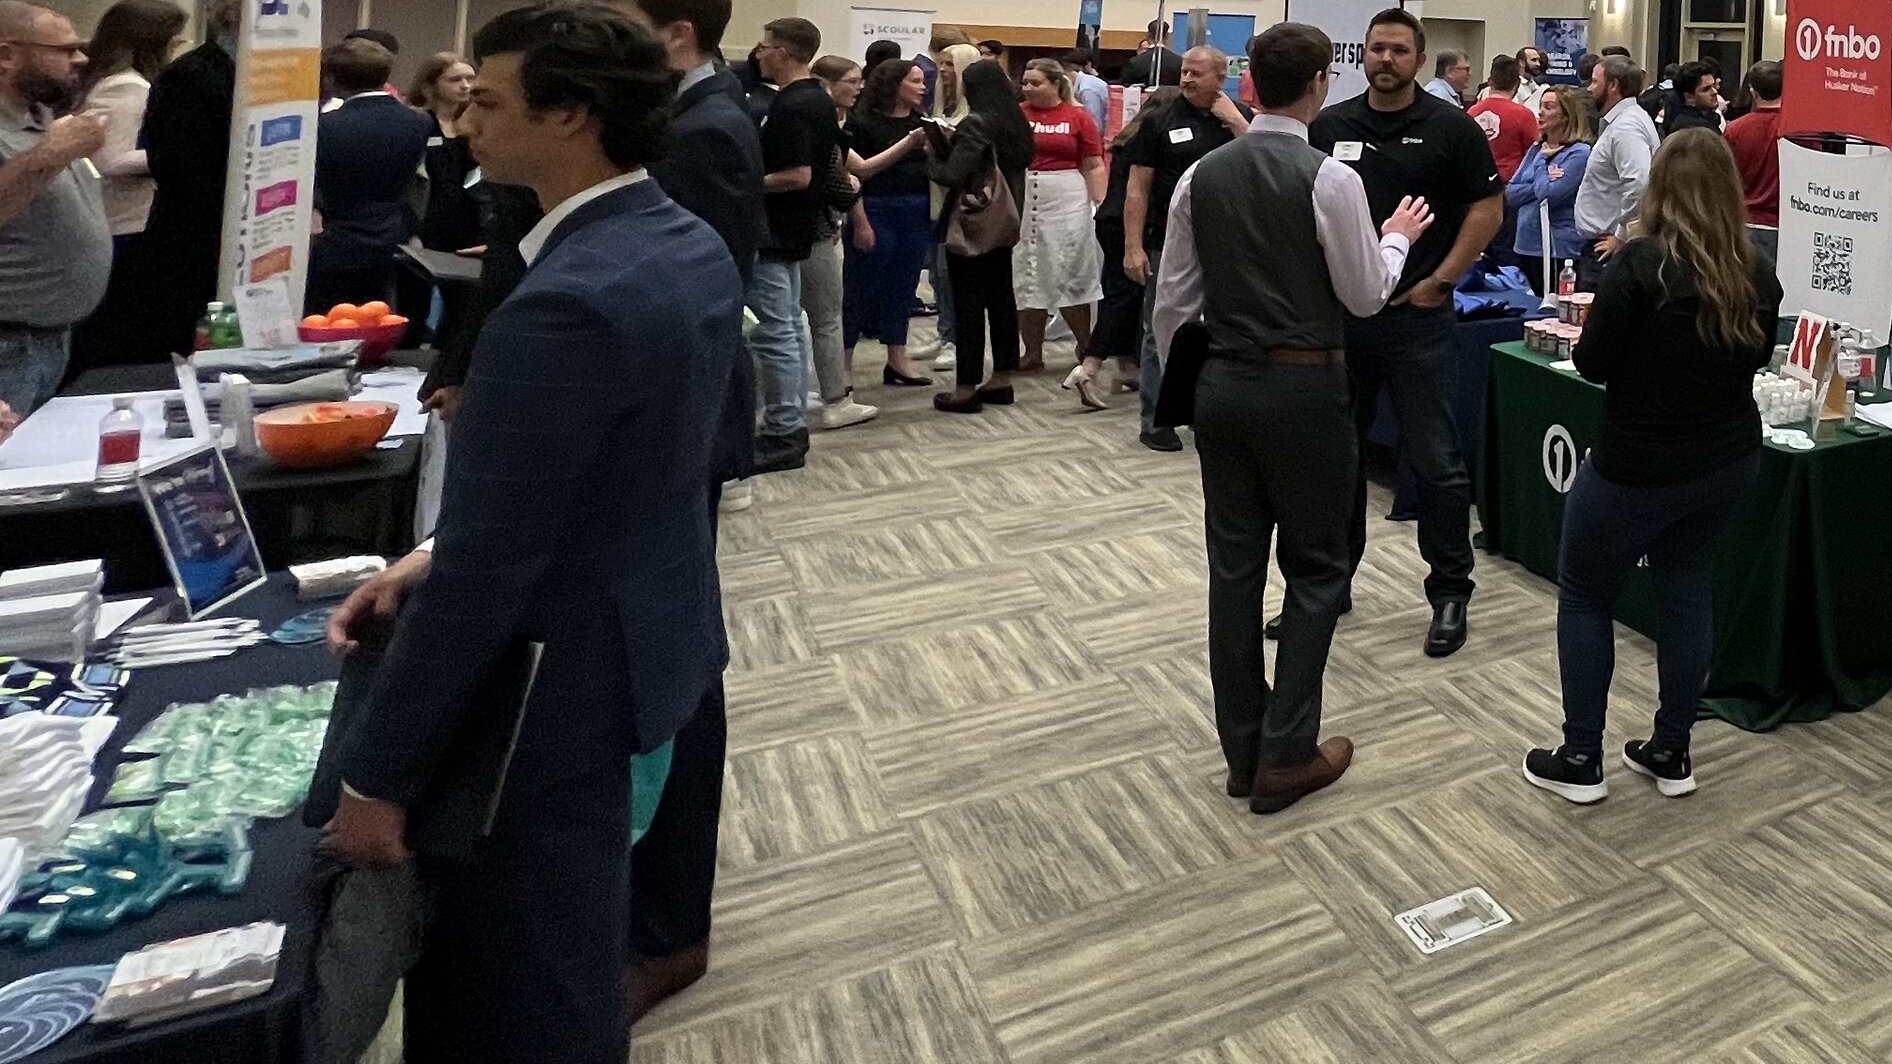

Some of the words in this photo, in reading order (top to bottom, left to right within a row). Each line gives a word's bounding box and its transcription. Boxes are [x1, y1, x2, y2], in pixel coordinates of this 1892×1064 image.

[877, 25, 926, 35] SCOULAR
[1824, 24, 1881, 61] fnbo
[1333, 42, 1365, 70] ersp
[1034, 121, 1070, 134] hudl
[1807, 181, 1831, 198] Find
[1832, 190, 1846, 200] us
[1847, 190, 1860, 201] at
[1789, 194, 1879, 224] fnbo.com/careers
[1790, 317, 1823, 370] N
